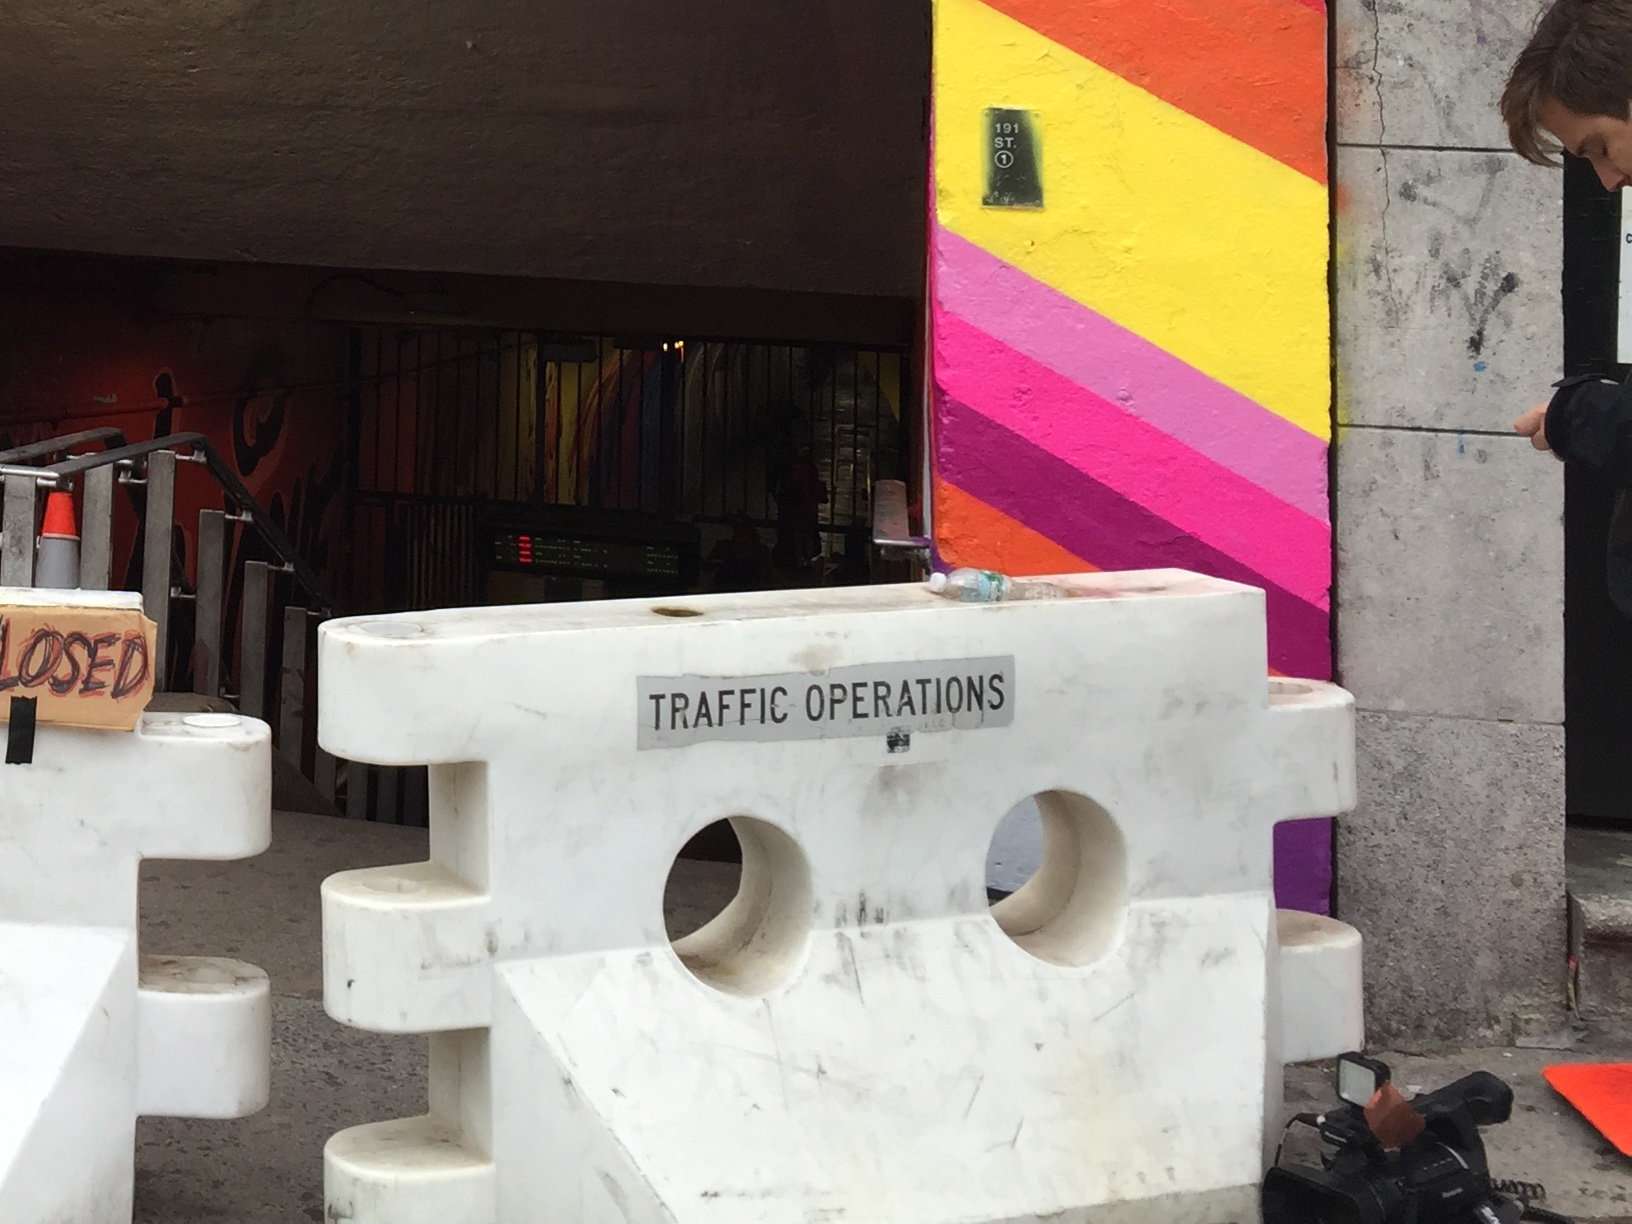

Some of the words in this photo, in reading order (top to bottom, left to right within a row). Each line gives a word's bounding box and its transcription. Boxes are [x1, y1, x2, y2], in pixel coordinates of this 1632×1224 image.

[995, 123, 1019, 133] 191
[994, 137, 1017, 149] ST.
[649, 686, 788, 731] TRAFFIC
[805, 673, 1006, 723] OPERATIONS
